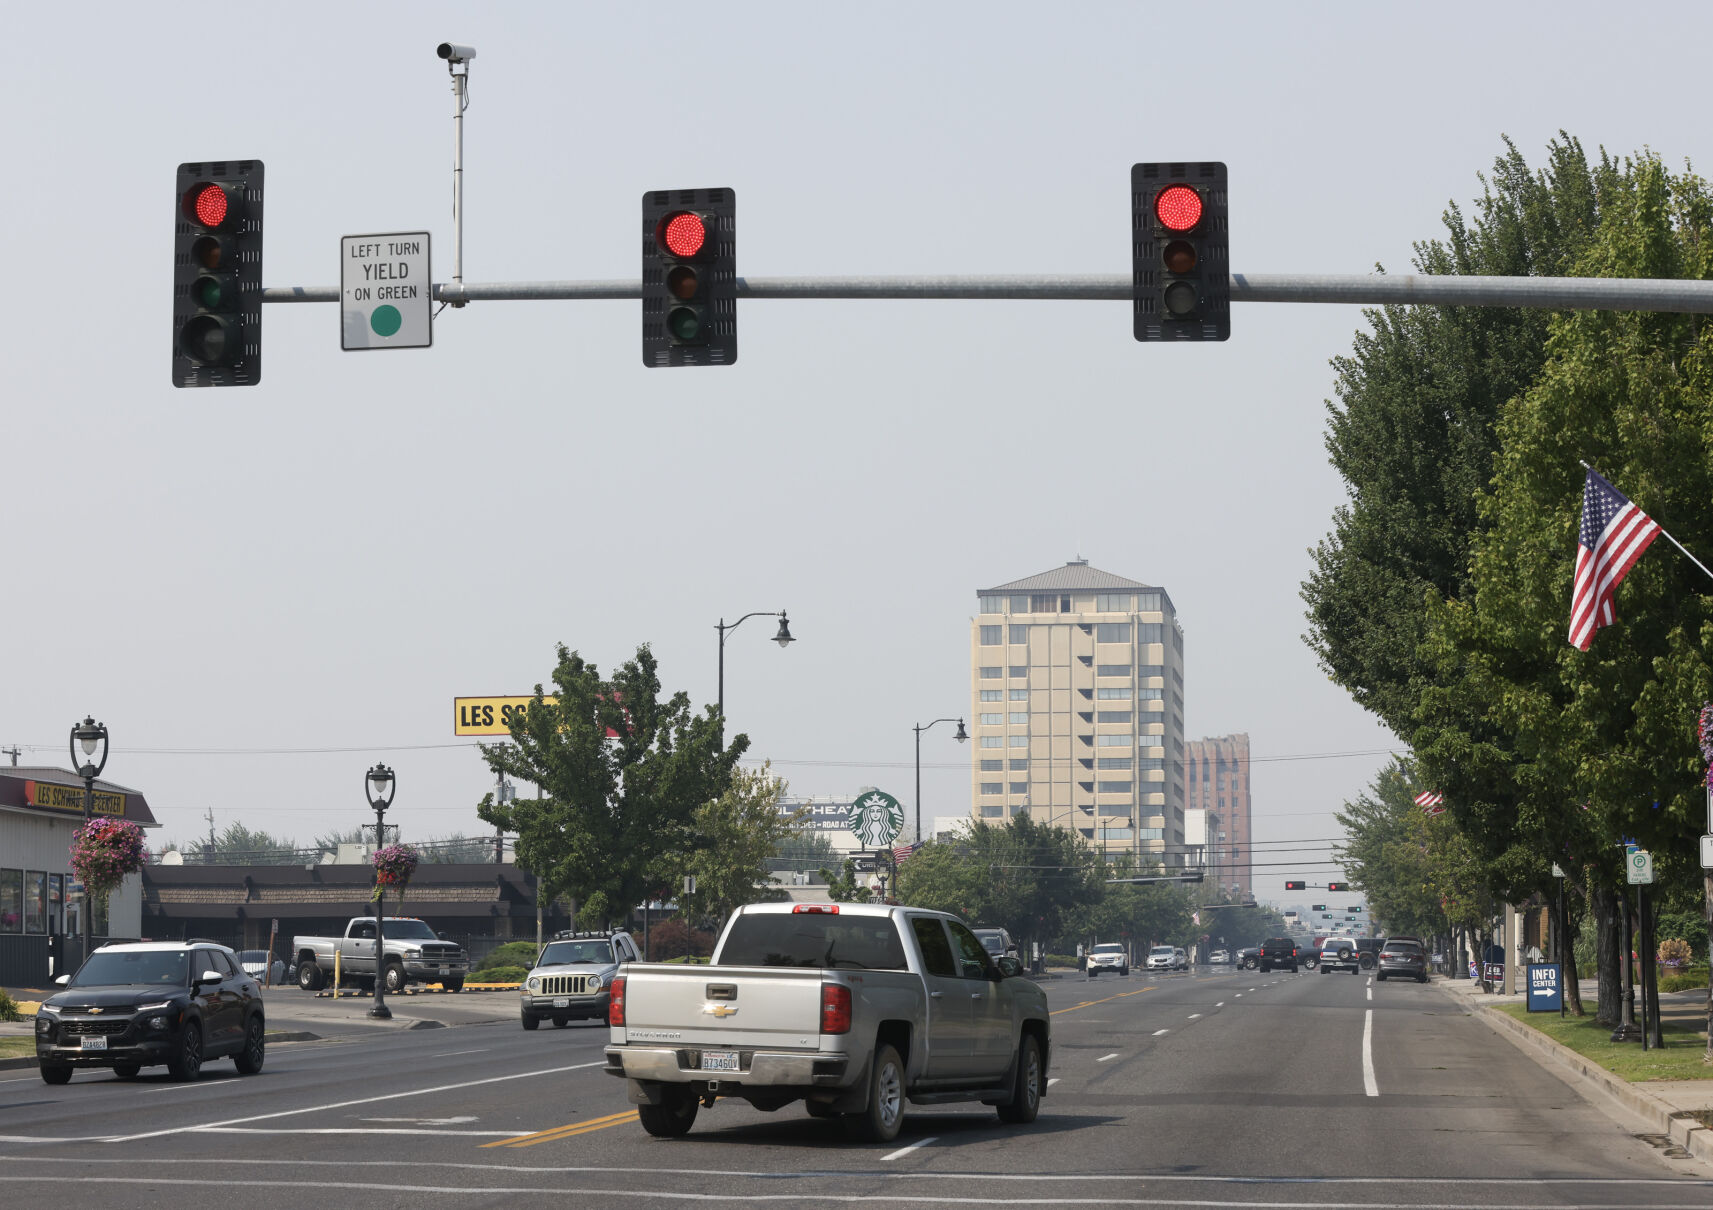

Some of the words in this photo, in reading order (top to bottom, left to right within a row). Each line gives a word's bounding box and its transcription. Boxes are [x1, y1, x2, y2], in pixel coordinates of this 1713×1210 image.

[351, 243, 381, 258] LEFT
[388, 242, 420, 256] TURN
[363, 262, 409, 281] YIELD
[354, 287, 371, 301] ON
[377, 285, 417, 300] GREEN
[461, 704, 494, 727] LES
[38, 786, 50, 805] LES
[97, 794, 121, 813] CENTER
[1532, 968, 1556, 980] INFO
[1532, 980, 1556, 988] CENTER
